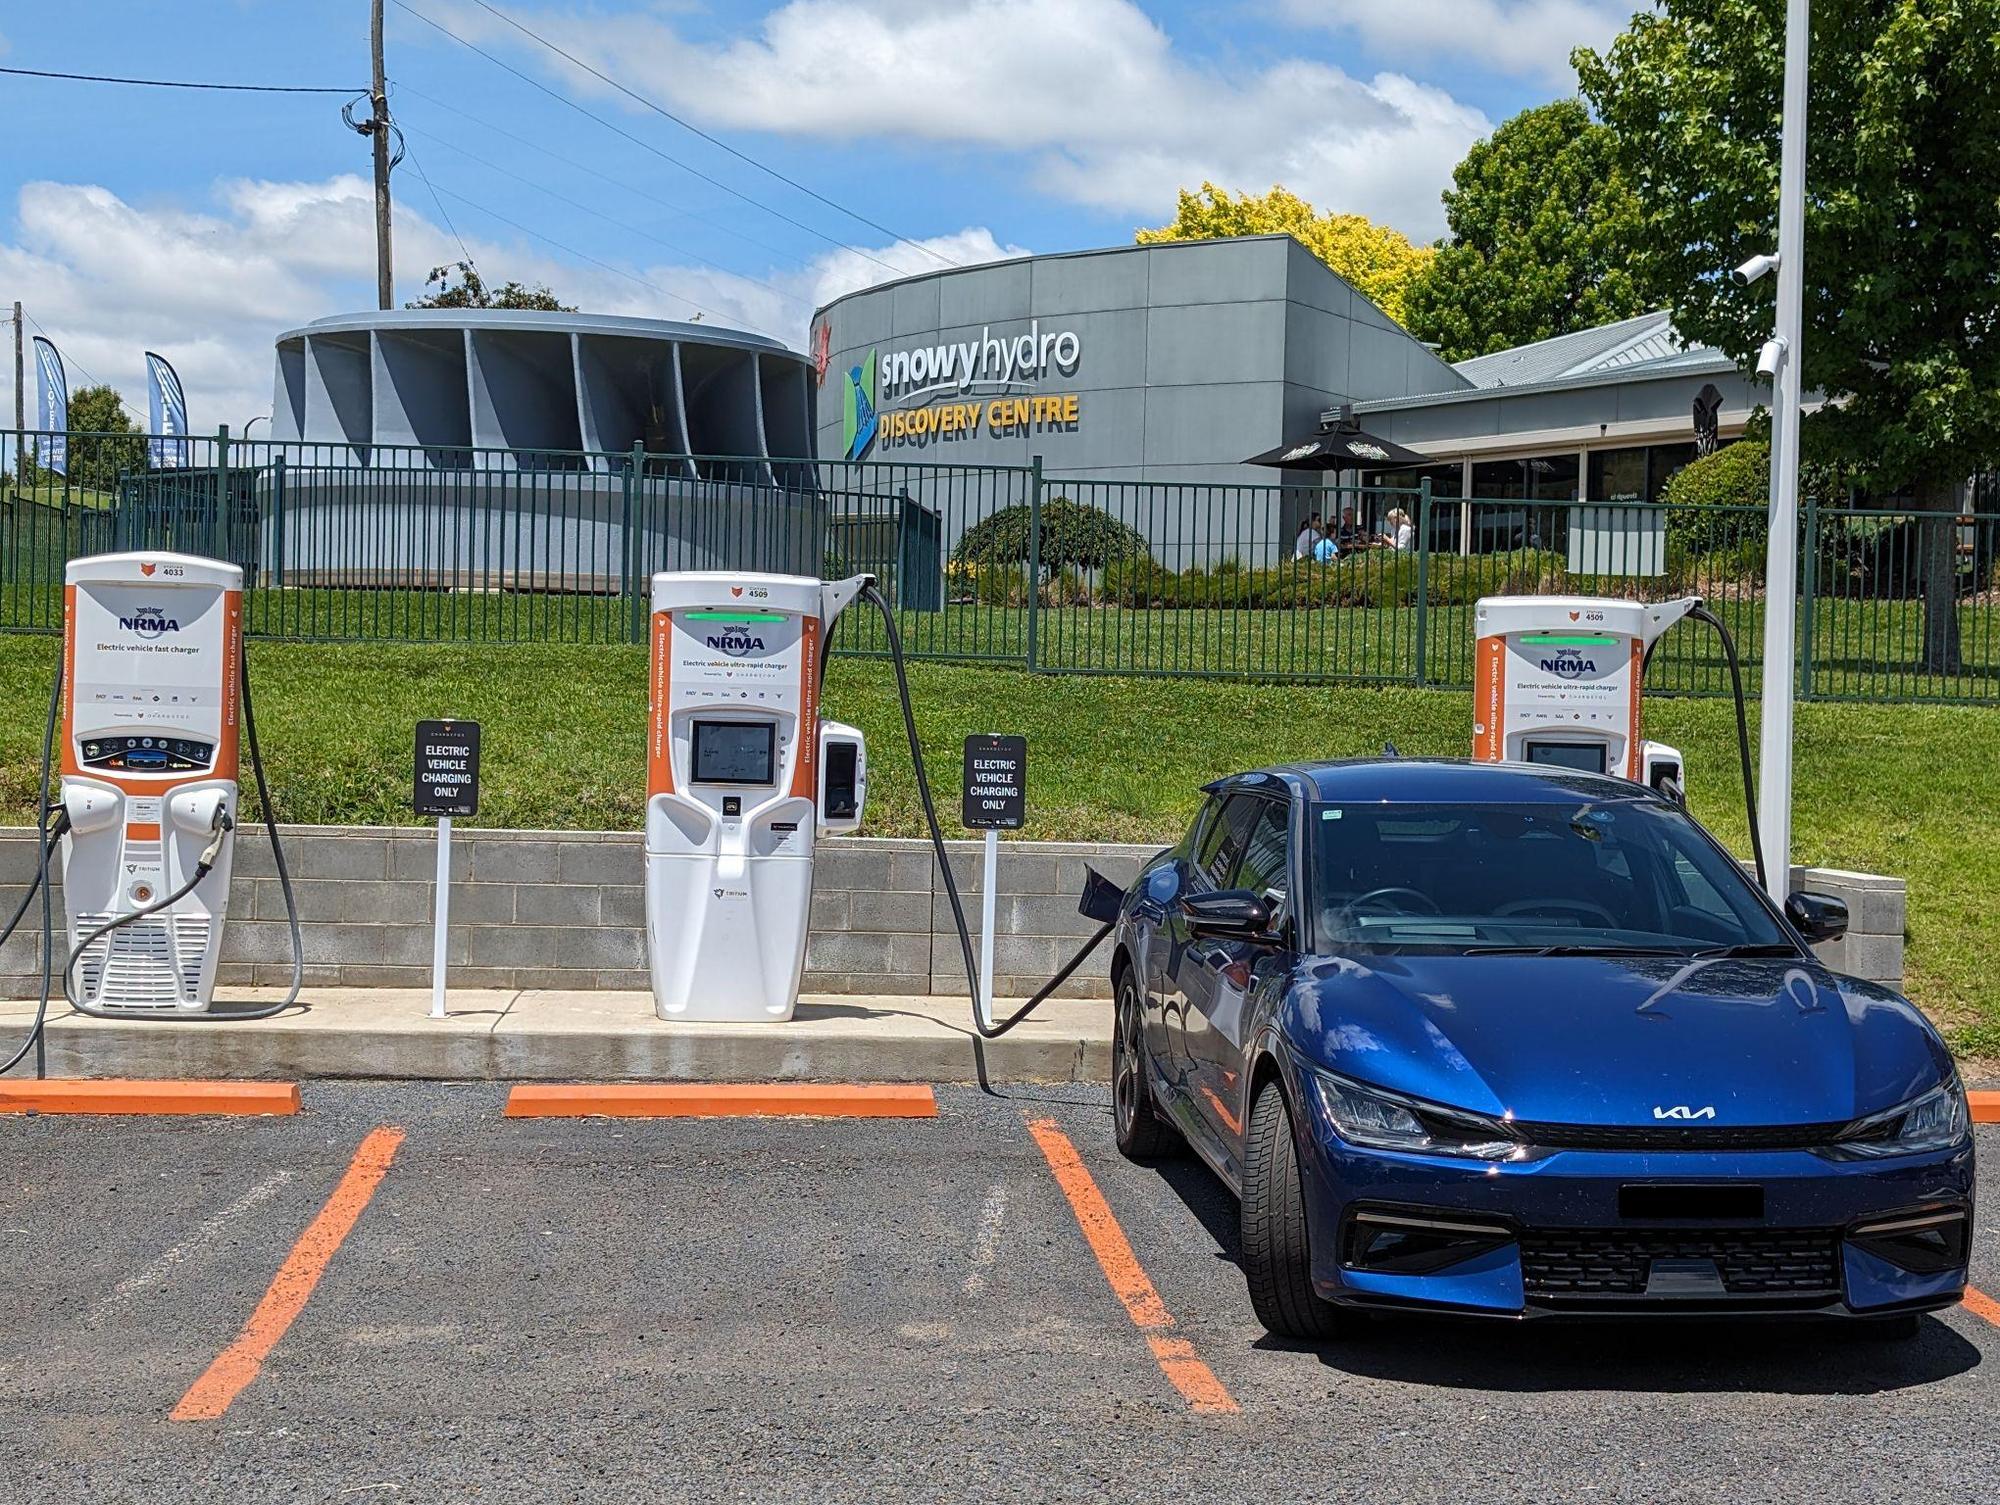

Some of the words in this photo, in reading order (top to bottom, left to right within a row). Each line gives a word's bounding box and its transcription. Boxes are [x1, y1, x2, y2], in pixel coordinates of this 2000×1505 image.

[880, 402, 981, 438] DISCOVERY
[987, 395, 1078, 426] CENTRE
[749, 590, 768, 598] 4509
[119, 617, 180, 632] NRMA
[97, 643, 125, 651] Electric
[127, 644, 153, 652] vehicle
[171, 646, 200, 654] charger
[706, 637, 765, 650] NRMA
[807, 639, 815, 664] charger
[730, 660, 763, 669] ultra-rapid
[1491, 656, 1499, 684] Electric
[1540, 659, 1596, 672] NRMA
[1489, 712, 1498, 751] ultra-rapid
[655, 730, 663, 759] charger
[425, 745, 470, 756] ELECTRIC
[428, 759, 467, 770] VEHICLE
[973, 759, 1016, 770] ELECTRIC
[421, 773, 472, 784] CHARGING
[975, 773, 1013, 783] VEHICLE
[434, 787, 459, 797] ONLY
[970, 786, 1018, 797] CHARGING
[982, 800, 1006, 810] ONLY
[1653, 1106, 1716, 1119] KIA
